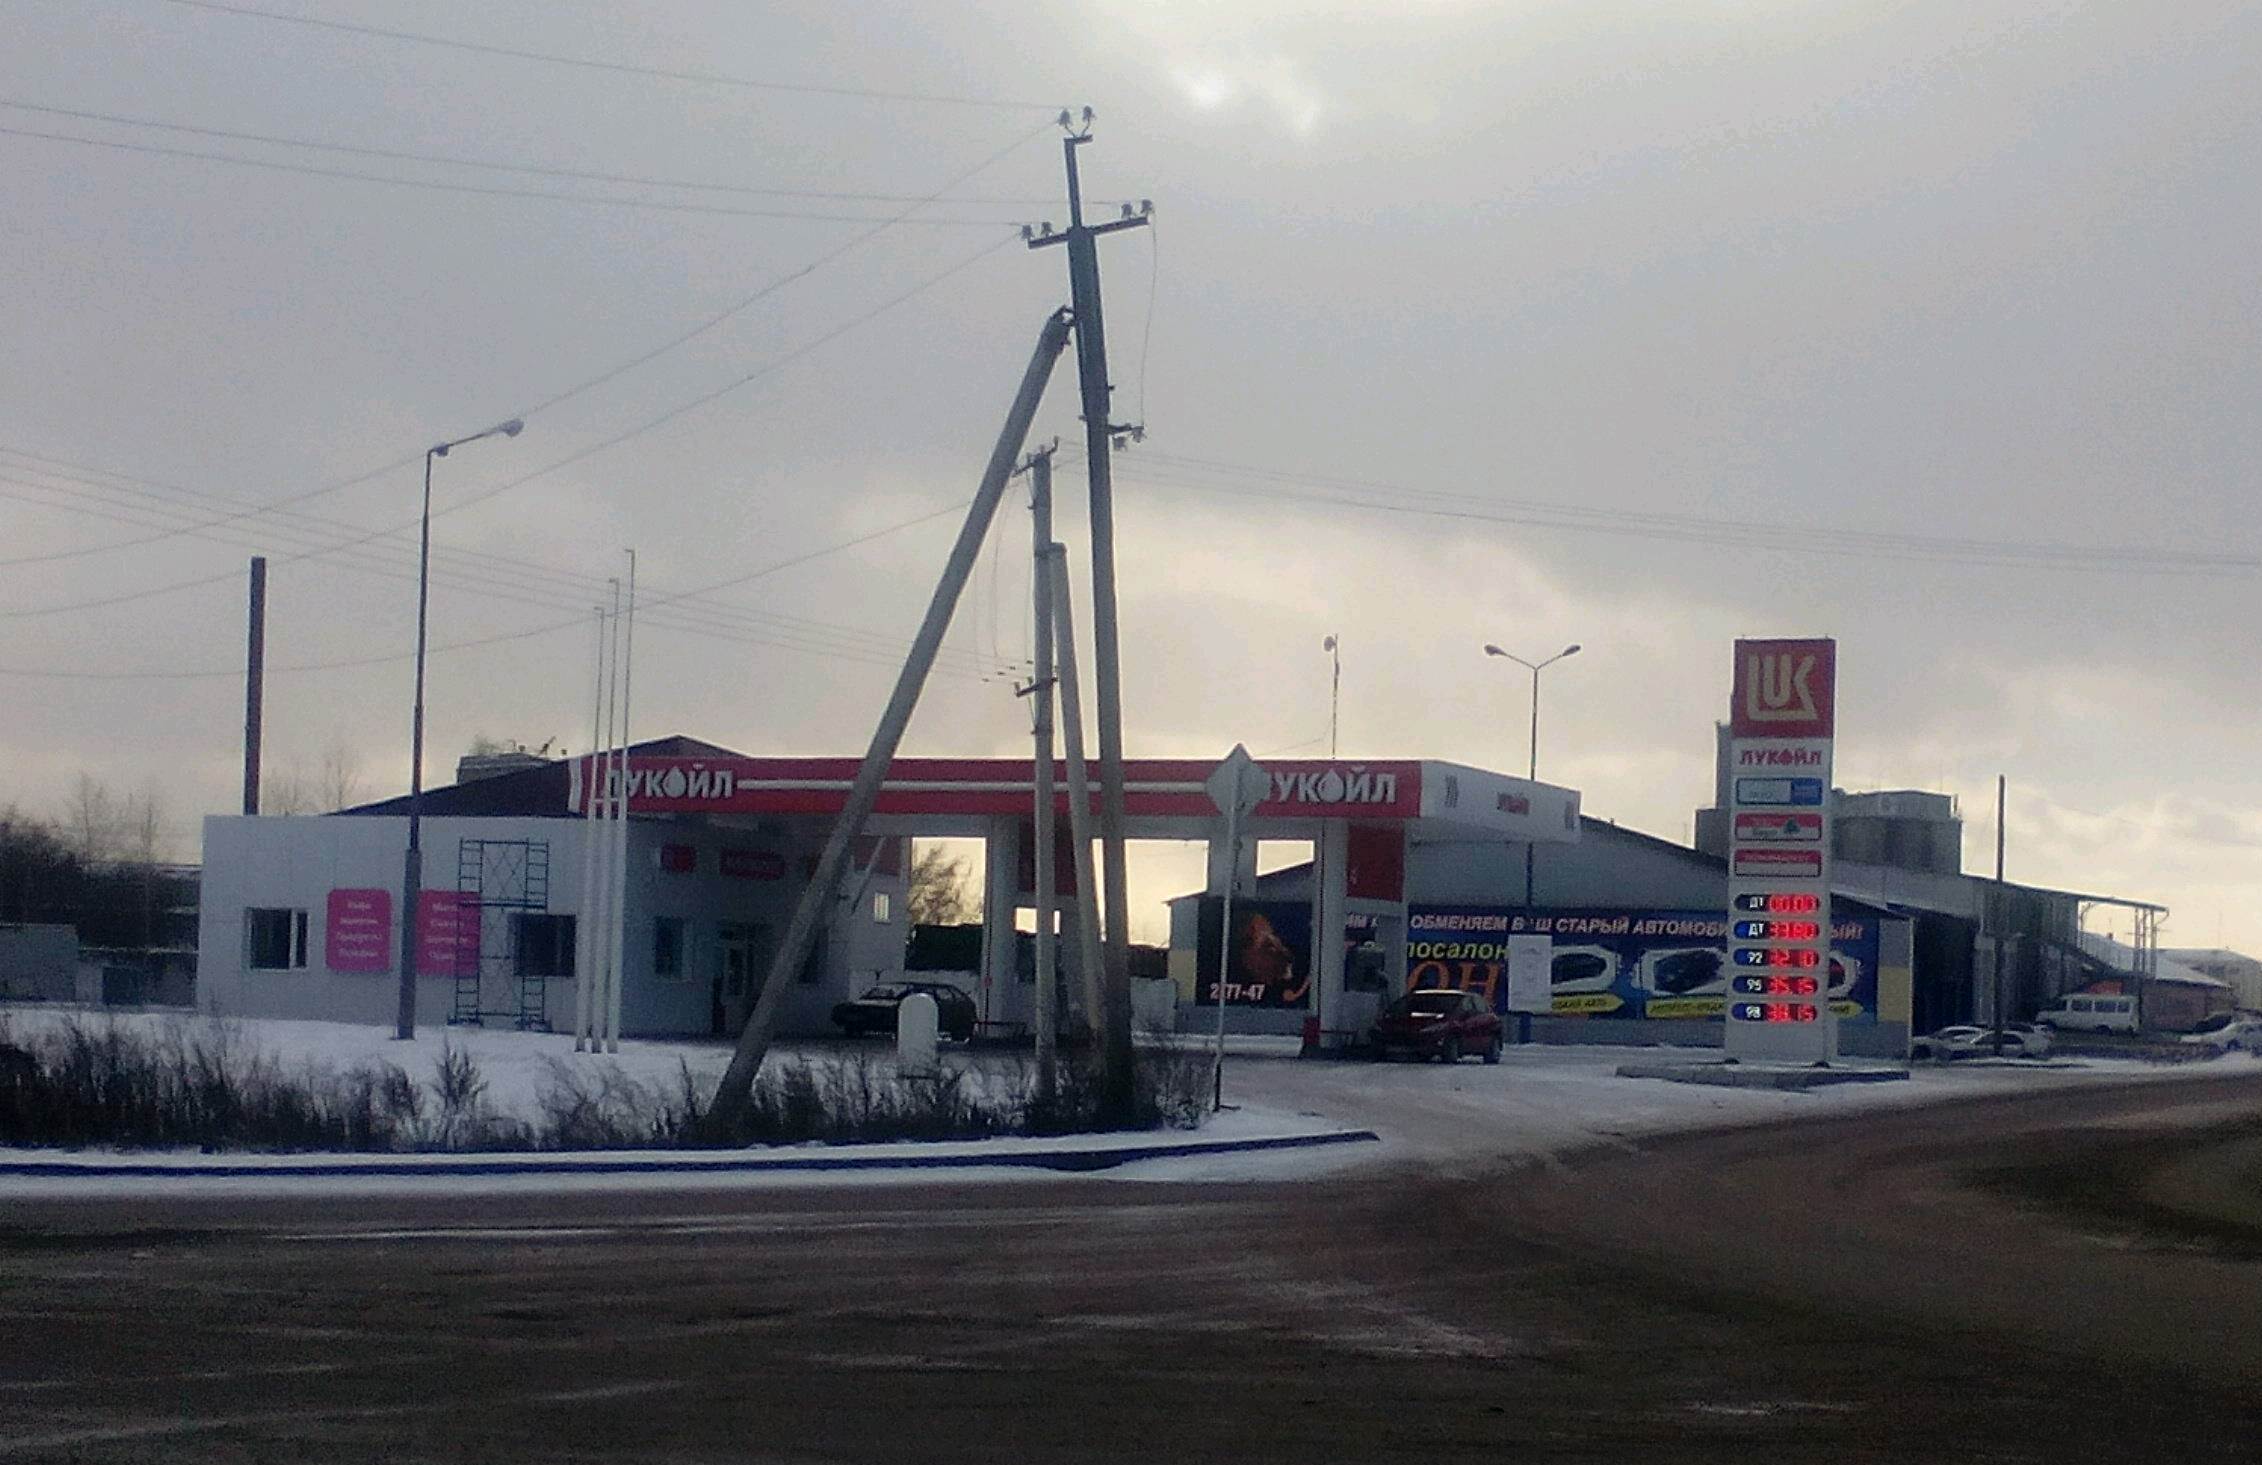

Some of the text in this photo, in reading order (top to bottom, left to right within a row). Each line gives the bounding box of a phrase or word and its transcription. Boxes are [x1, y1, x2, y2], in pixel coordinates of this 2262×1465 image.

[1273, 764, 1396, 804] УКОЙЛ
[1410, 914, 1507, 931] ОБМЕНЯЕМ
[1511, 915, 1551, 932] ВШ
[1555, 915, 1630, 935] СТАРЫЙ
[1633, 918, 1728, 937] АВТОМОБИ
[1748, 923, 1764, 936] ДТ
[1747, 951, 1762, 964] 92
[1746, 979, 1761, 992] 95
[1745, 1006, 1761, 1018] 98
